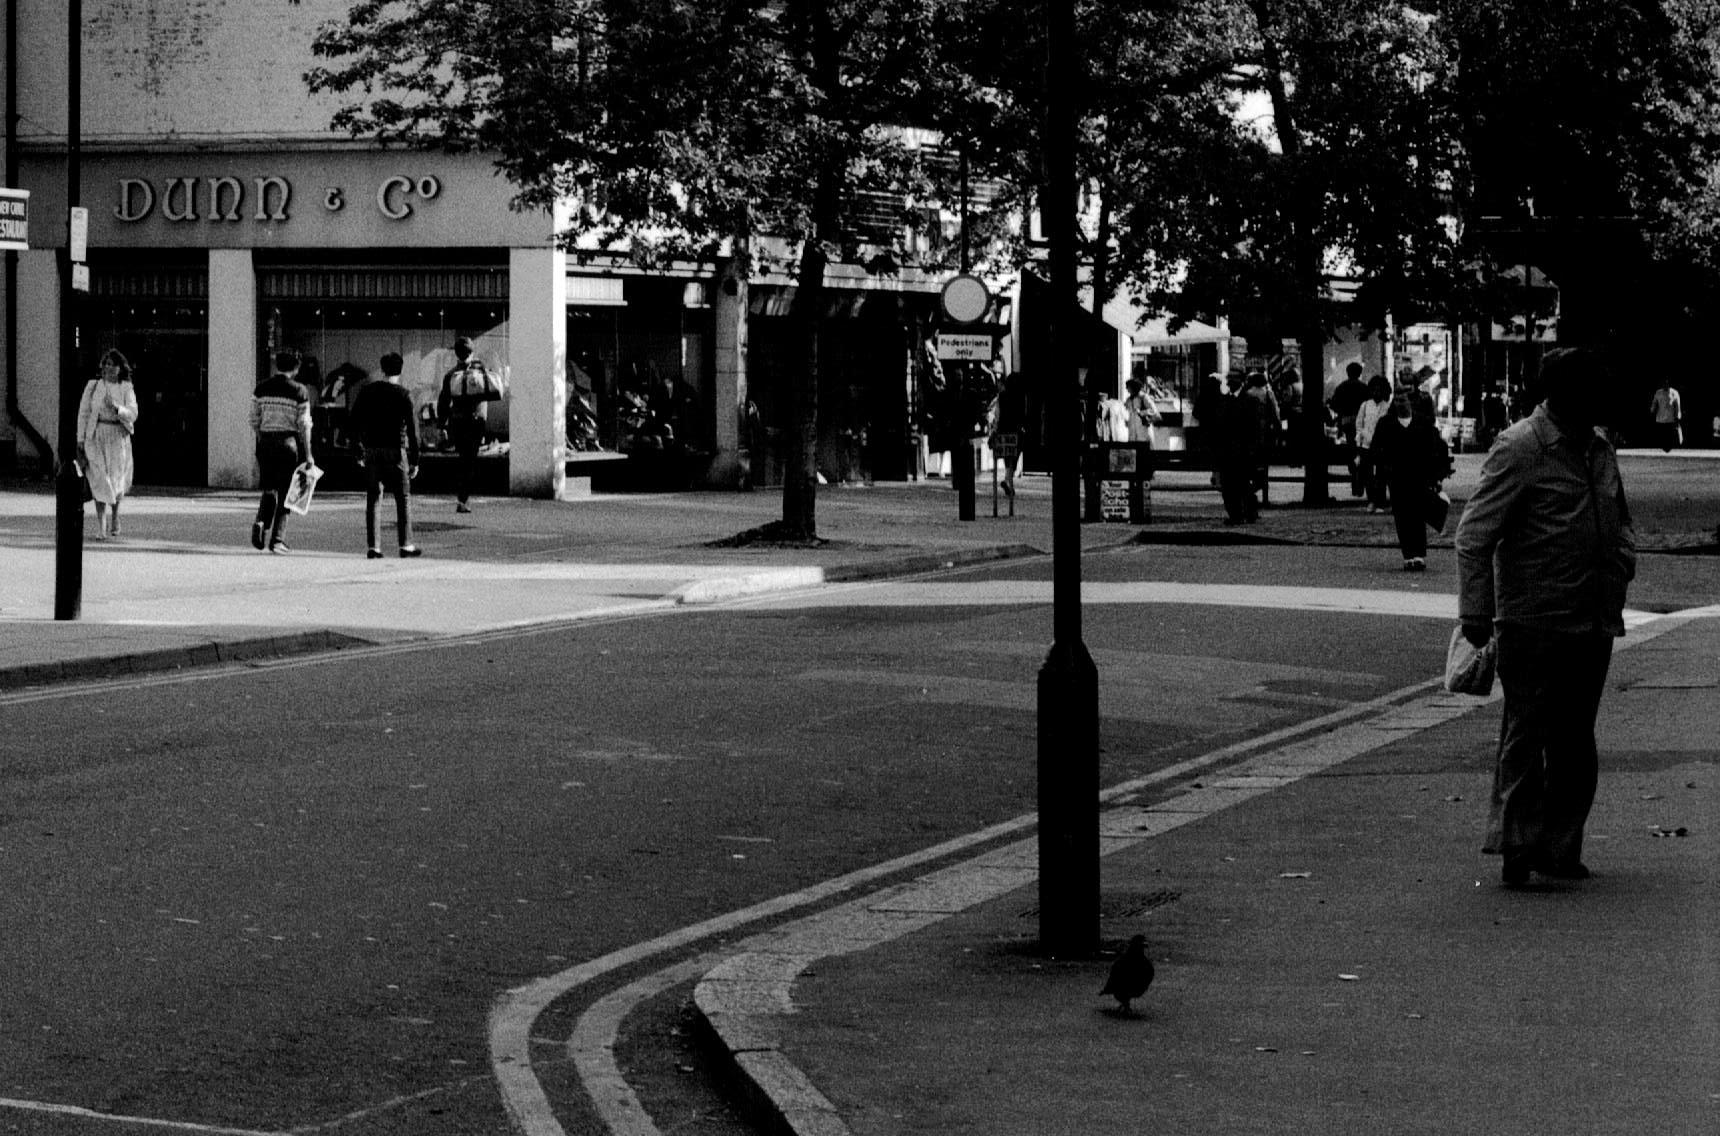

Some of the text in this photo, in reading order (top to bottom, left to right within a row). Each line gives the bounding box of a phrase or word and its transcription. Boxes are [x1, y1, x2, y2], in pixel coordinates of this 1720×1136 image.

[323, 187, 344, 211] &
[940, 338, 989, 347] Pedestrians
[955, 348, 974, 357] only
